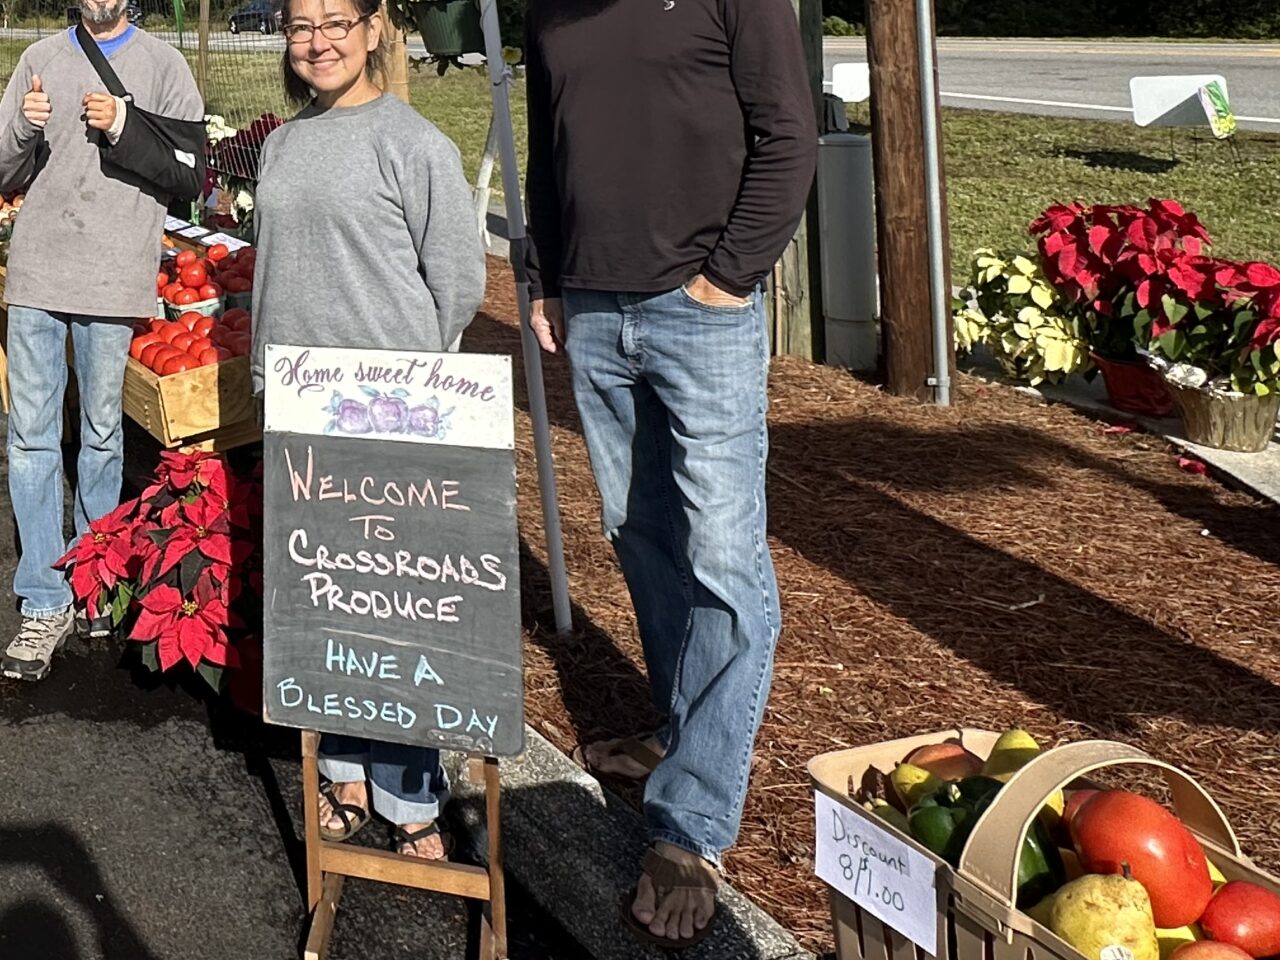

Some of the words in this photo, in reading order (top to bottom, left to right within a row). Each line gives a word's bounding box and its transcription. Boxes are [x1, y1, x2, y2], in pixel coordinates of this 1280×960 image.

[275, 350, 345, 398] Home
[354, 358, 427, 385] sweet
[424, 358, 496, 403] home
[284, 445, 471, 513] WELCOME
[288, 528, 507, 591] CROSSROADS
[300, 572, 464, 623] PRODUCE
[325, 638, 402, 680] HAVE
[413, 654, 445, 687] A
[276, 677, 418, 730] BLESSED
[433, 703, 499, 739] DAY
[831, 808, 907, 876] Discount
